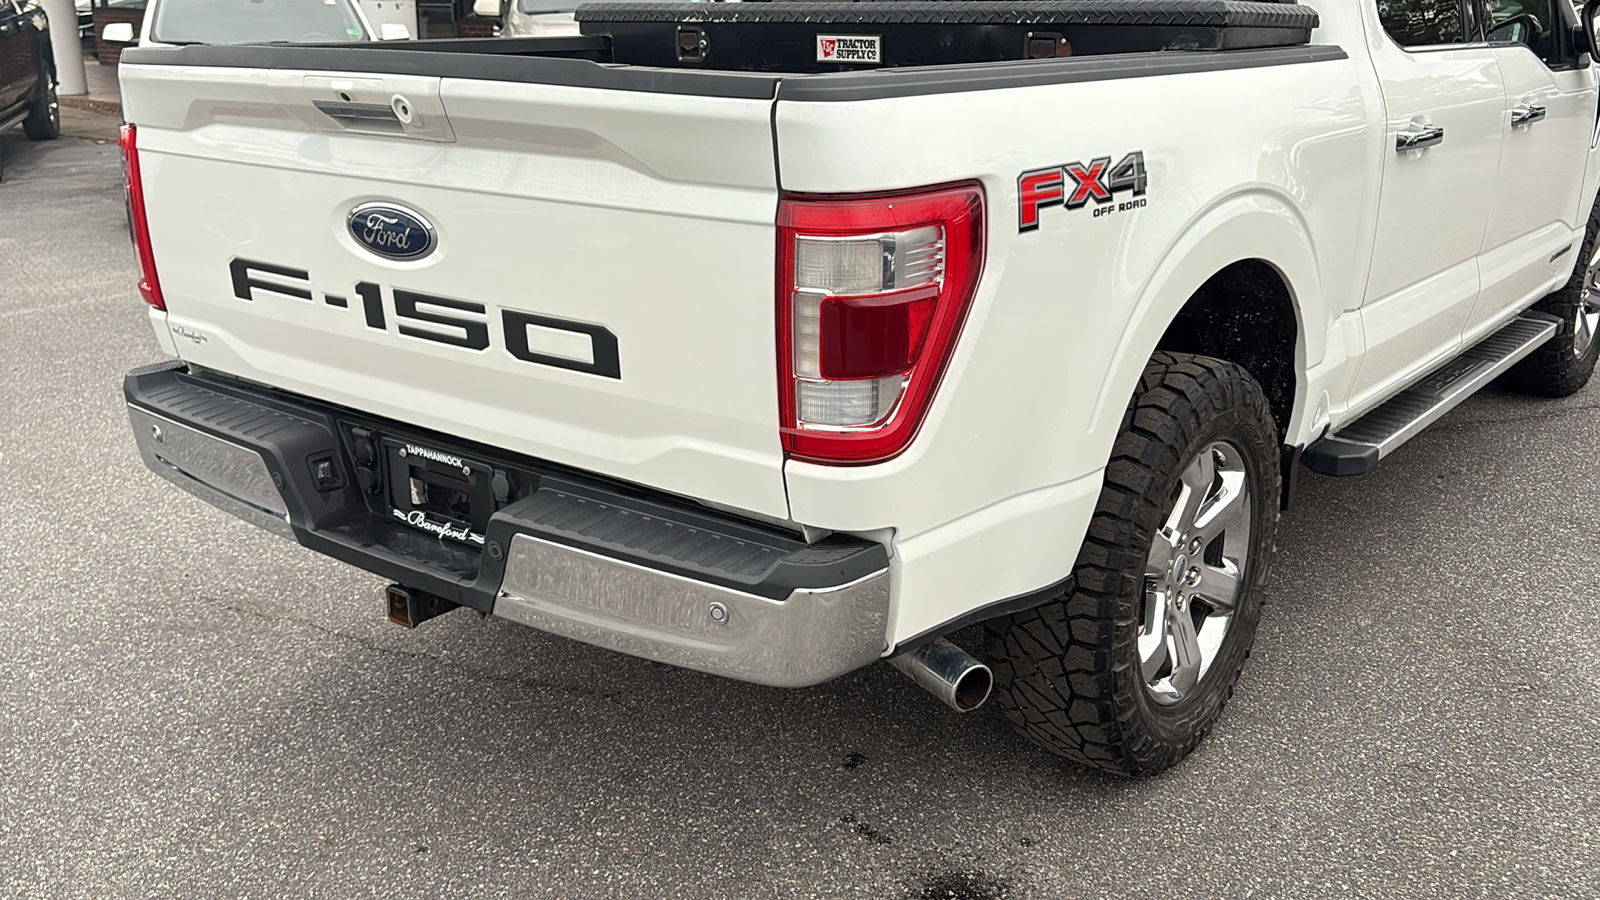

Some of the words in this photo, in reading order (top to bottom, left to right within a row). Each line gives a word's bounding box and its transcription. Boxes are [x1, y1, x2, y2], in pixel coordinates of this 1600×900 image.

[836, 39, 876, 49] TRACTOR
[836, 49, 866, 60] SUPPLY
[1017, 150, 1147, 235] FX4
[1093, 205, 1115, 218] OFF
[1118, 198, 1147, 212] ROAD
[363, 213, 411, 249] Ford
[229, 257, 621, 380] F-150
[406, 444, 463, 468] TAPPAHANNOCK
[407, 510, 468, 540] Bareford
